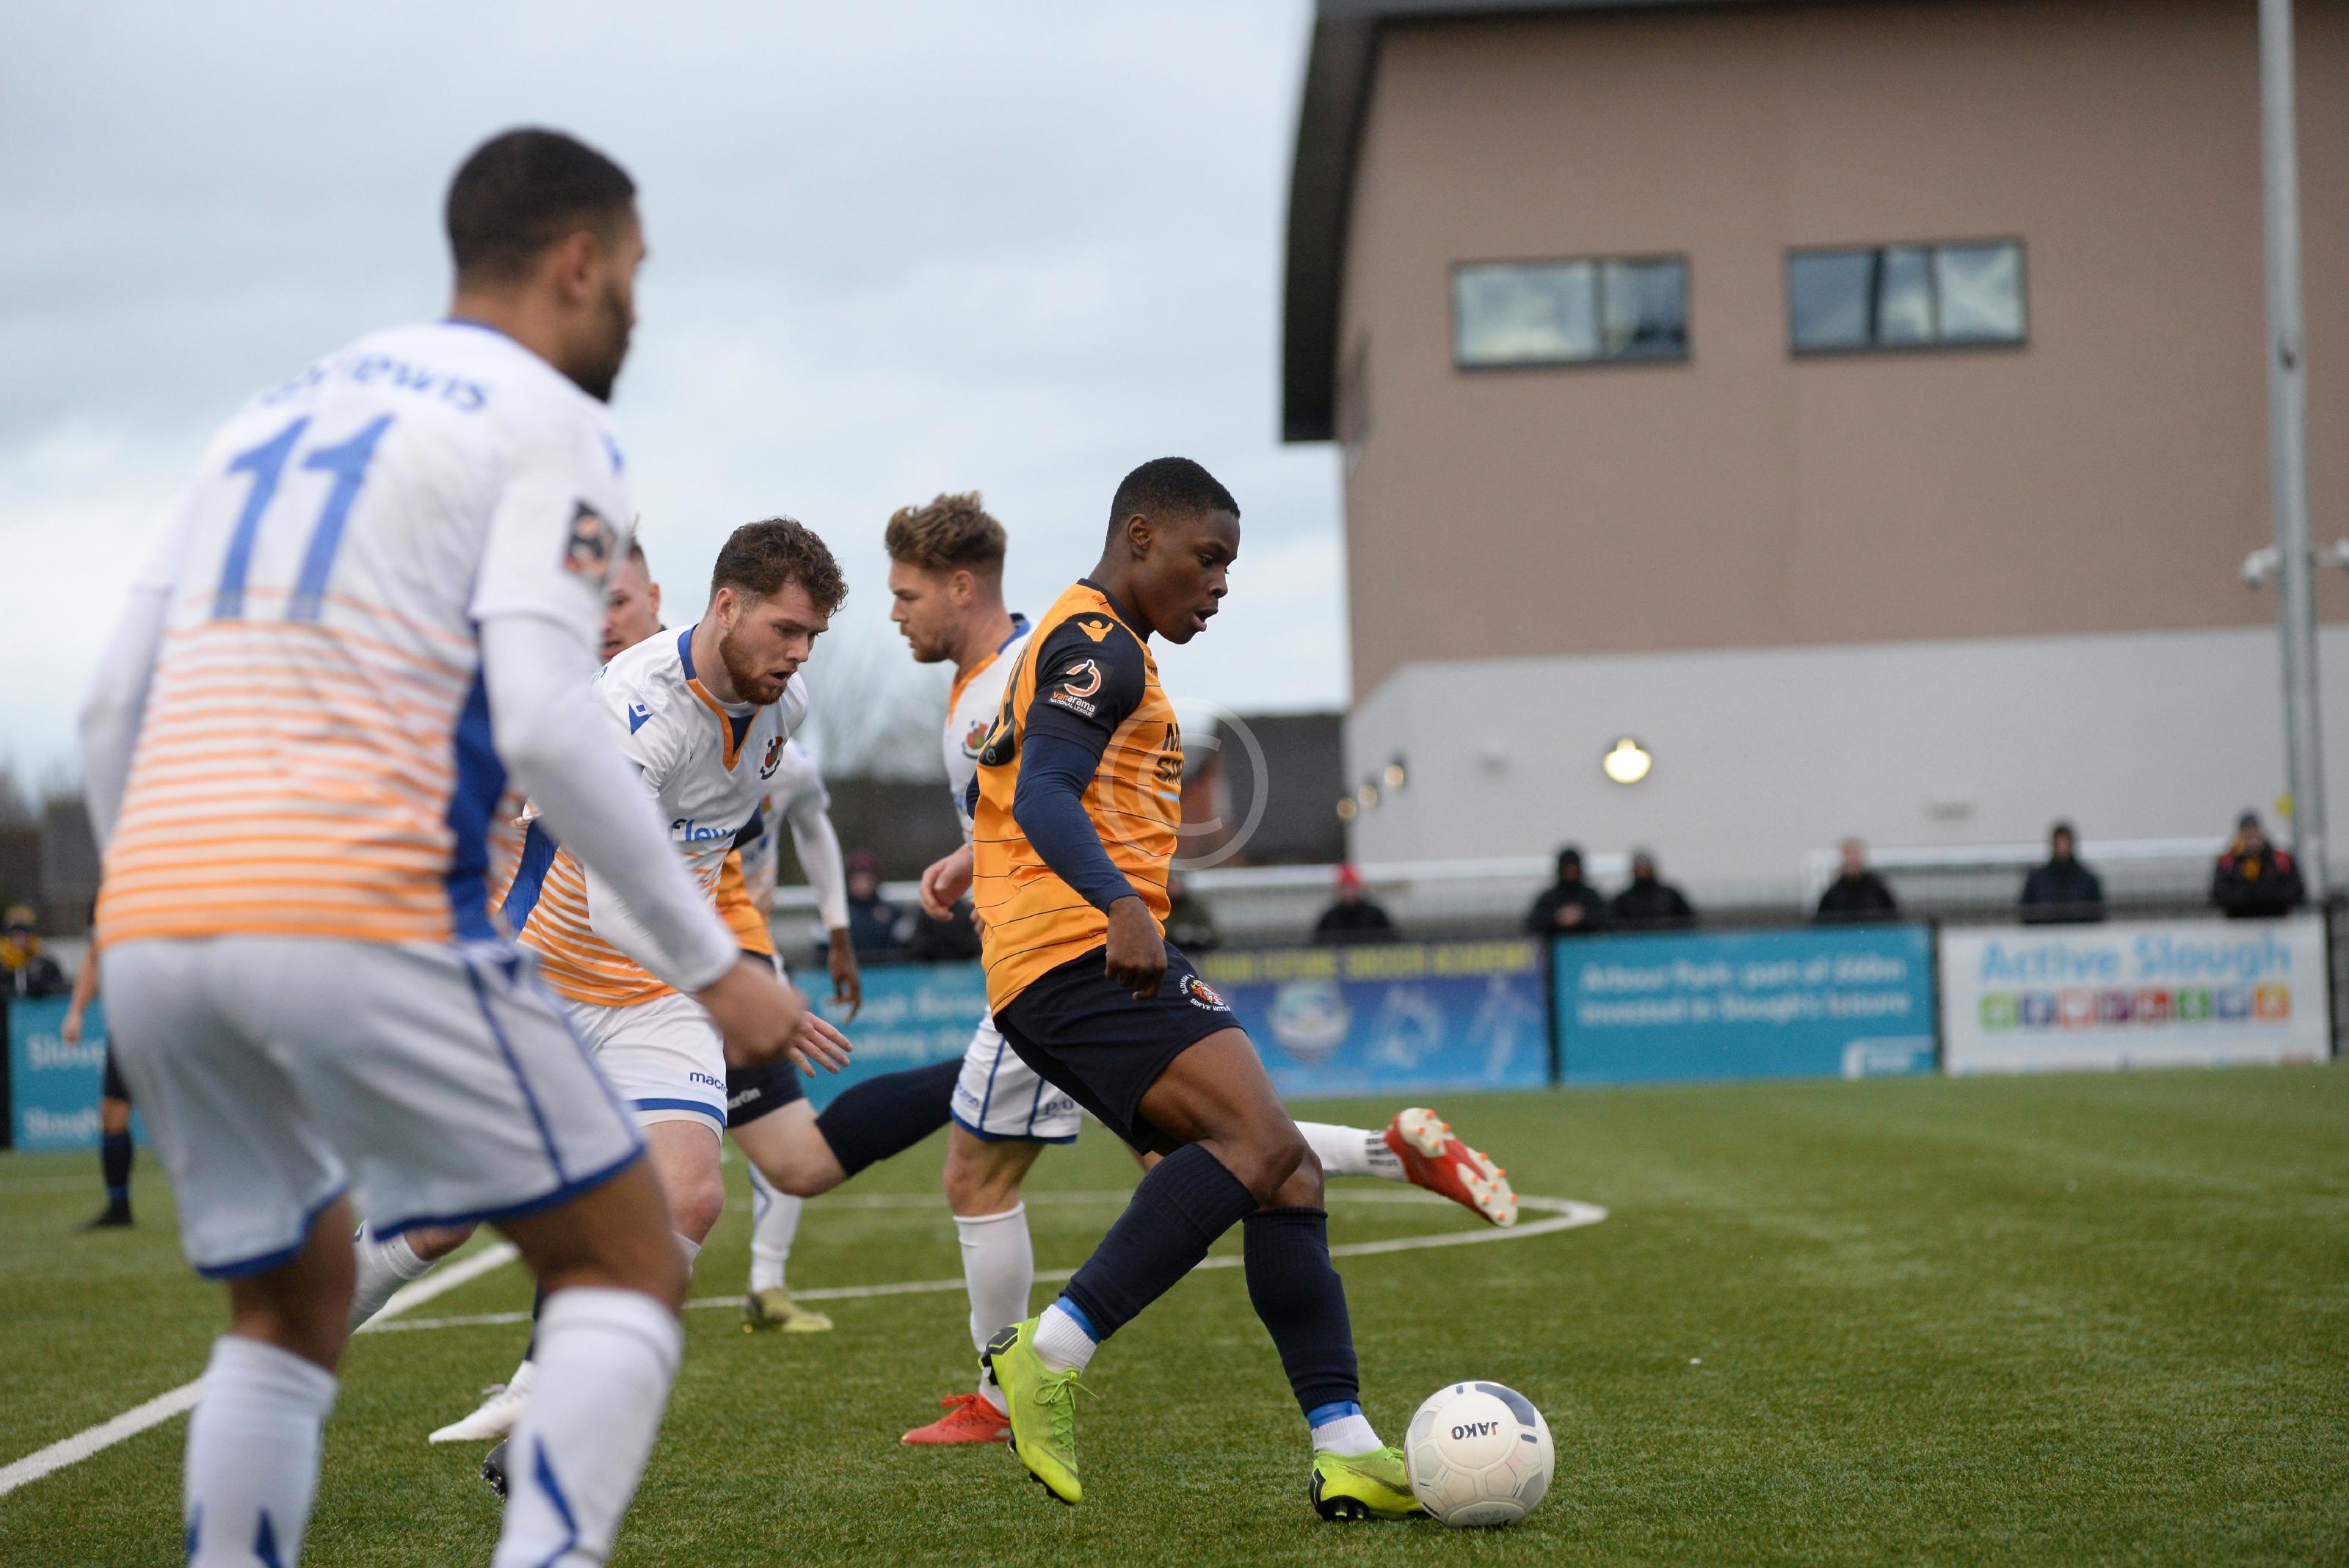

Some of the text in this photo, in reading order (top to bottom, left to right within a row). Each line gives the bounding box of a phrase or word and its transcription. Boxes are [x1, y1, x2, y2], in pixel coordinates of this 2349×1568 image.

[213, 414, 395, 621] 11
[1049, 697, 1093, 717] NATIONAL LEAGUE
[1053, 692, 1095, 712] vanarama
[1983, 931, 2291, 980] Active Slough
[1451, 1421, 1499, 1440] JAKO
